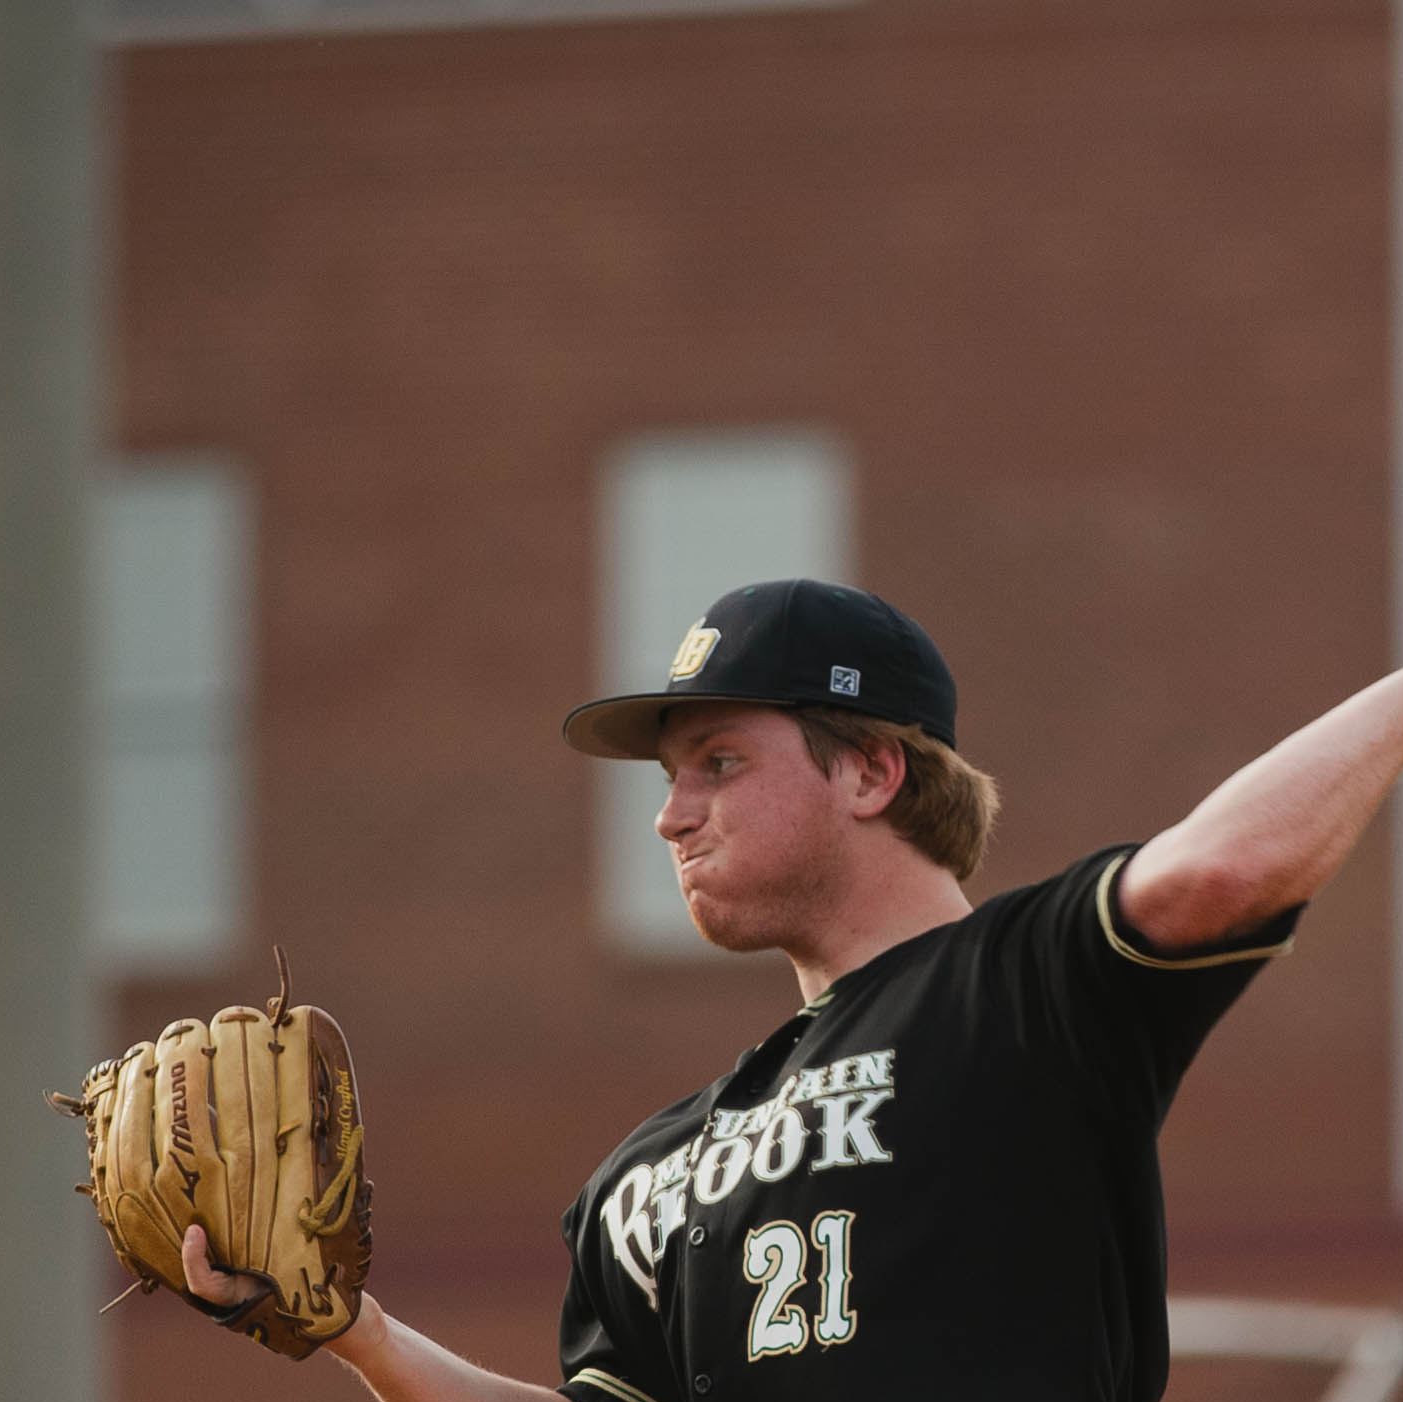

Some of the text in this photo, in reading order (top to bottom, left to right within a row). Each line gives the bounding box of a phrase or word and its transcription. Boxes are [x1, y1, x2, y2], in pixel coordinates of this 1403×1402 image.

[334, 1067, 354, 1118] Crafted
[652, 1049, 896, 1196] MUNAIN
[743, 1210, 857, 1362] 21
